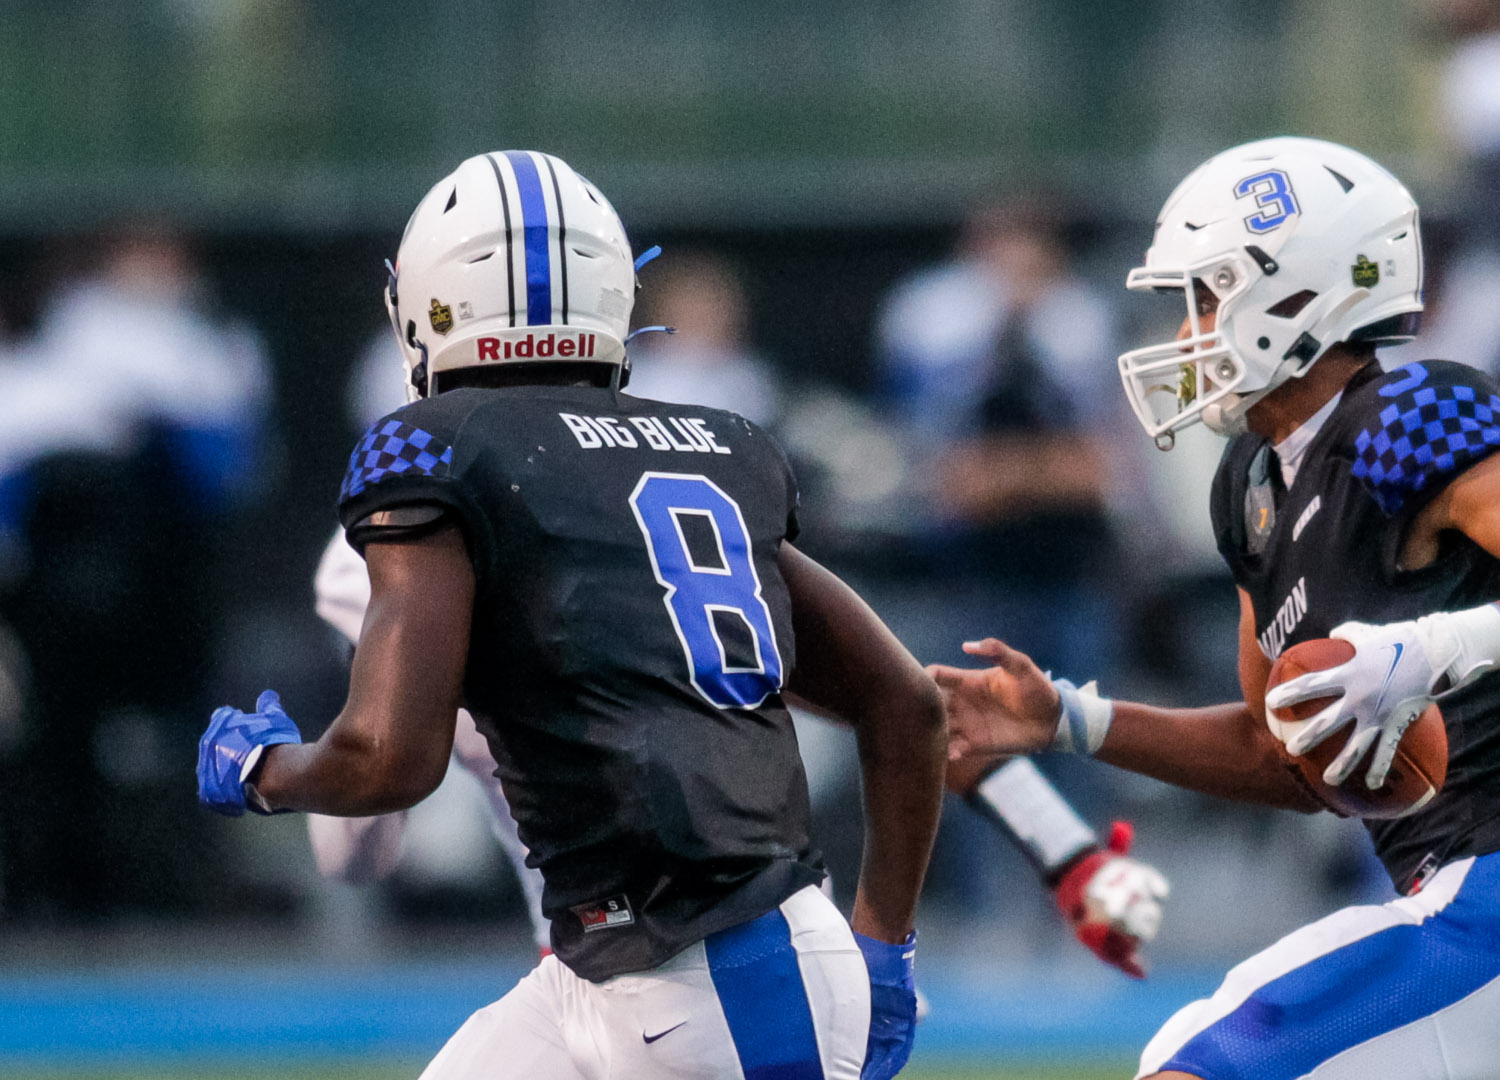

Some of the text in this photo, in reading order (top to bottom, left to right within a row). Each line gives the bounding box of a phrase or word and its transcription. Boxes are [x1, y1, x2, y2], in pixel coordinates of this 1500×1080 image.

[1233, 168, 1302, 235] 3
[477, 334, 596, 361] Riddell
[558, 412, 733, 454] BIG BLUE
[628, 470, 783, 710] 8
[608, 900, 618, 911] S
